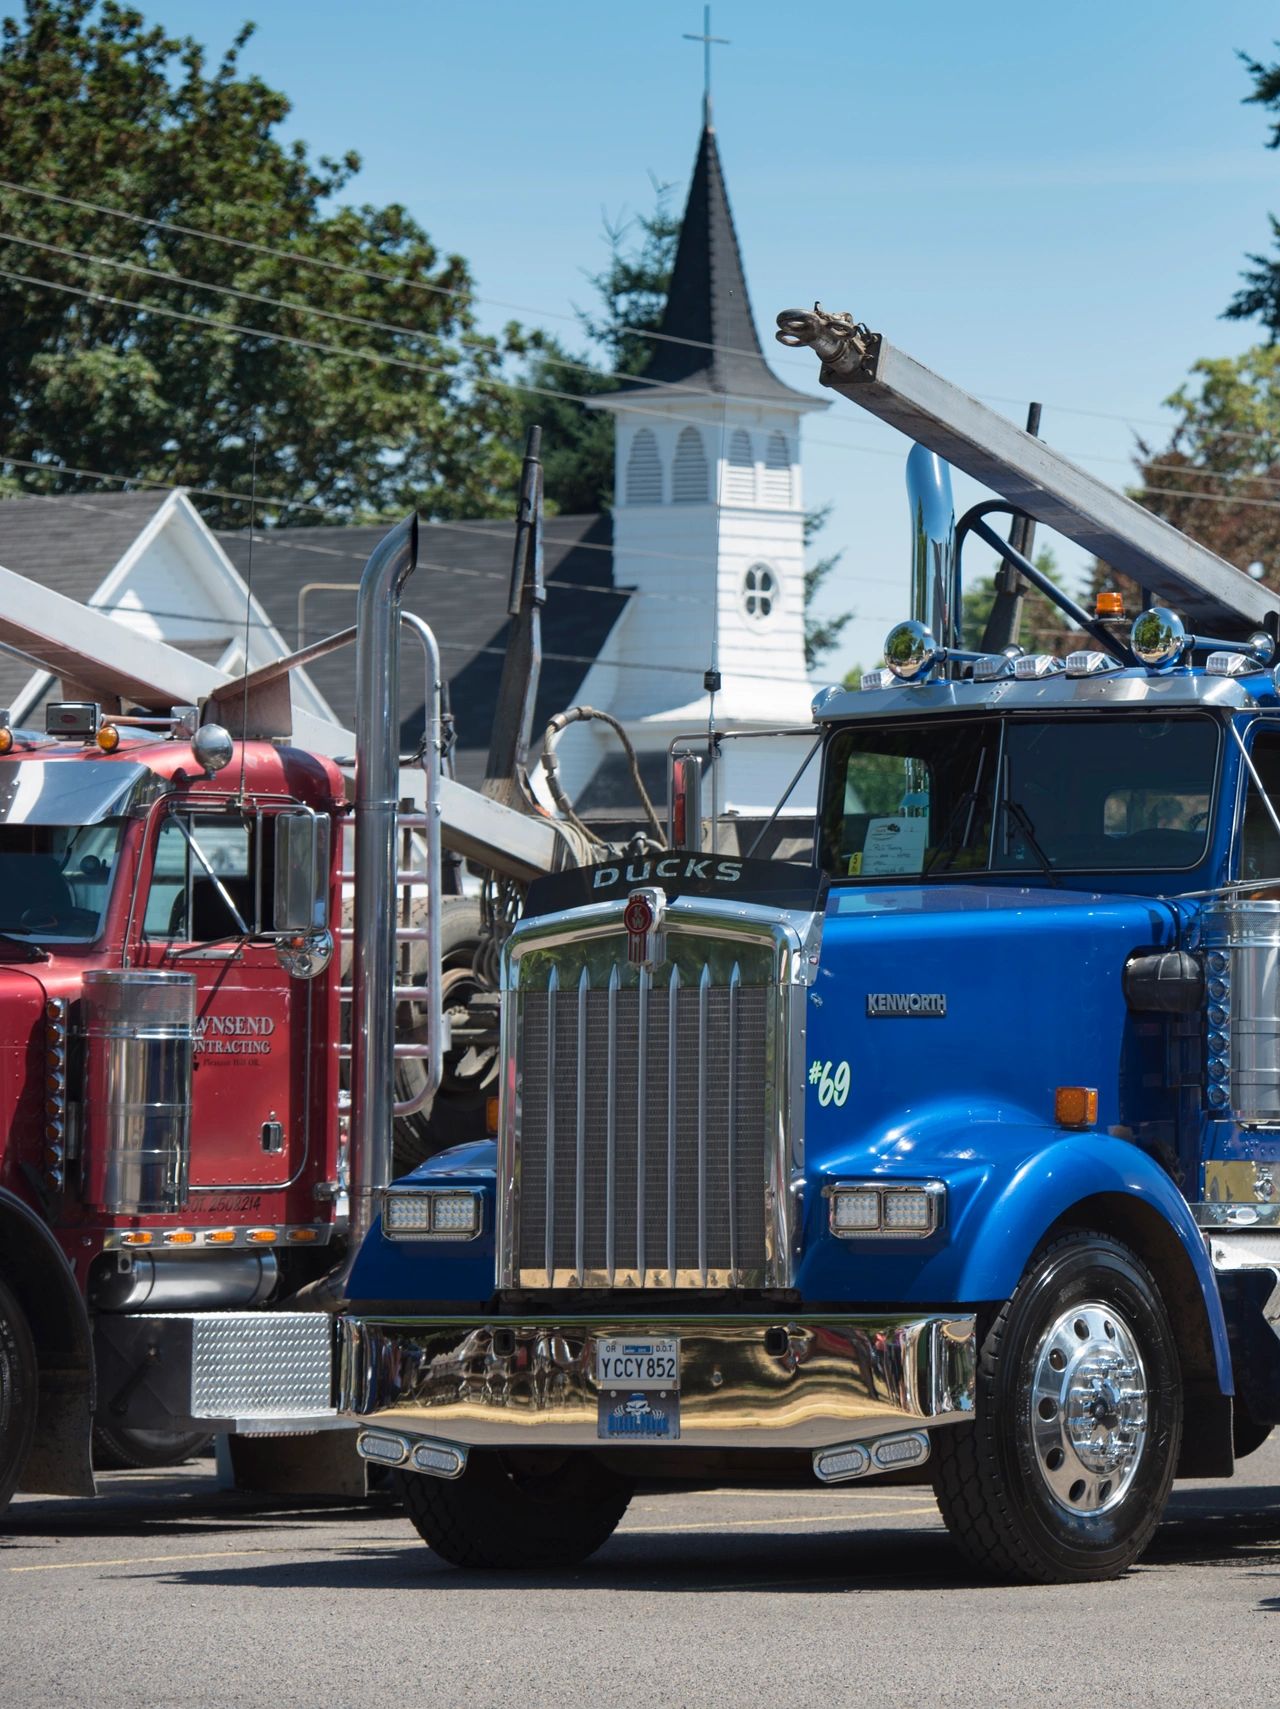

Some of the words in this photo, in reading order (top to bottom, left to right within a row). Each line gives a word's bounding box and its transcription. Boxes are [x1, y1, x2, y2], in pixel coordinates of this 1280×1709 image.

[593, 858, 743, 889] DUCKS
[867, 992, 947, 1012] KENWORTH
[808, 1060, 851, 1107] #69
[606, 1345, 617, 1353] OR
